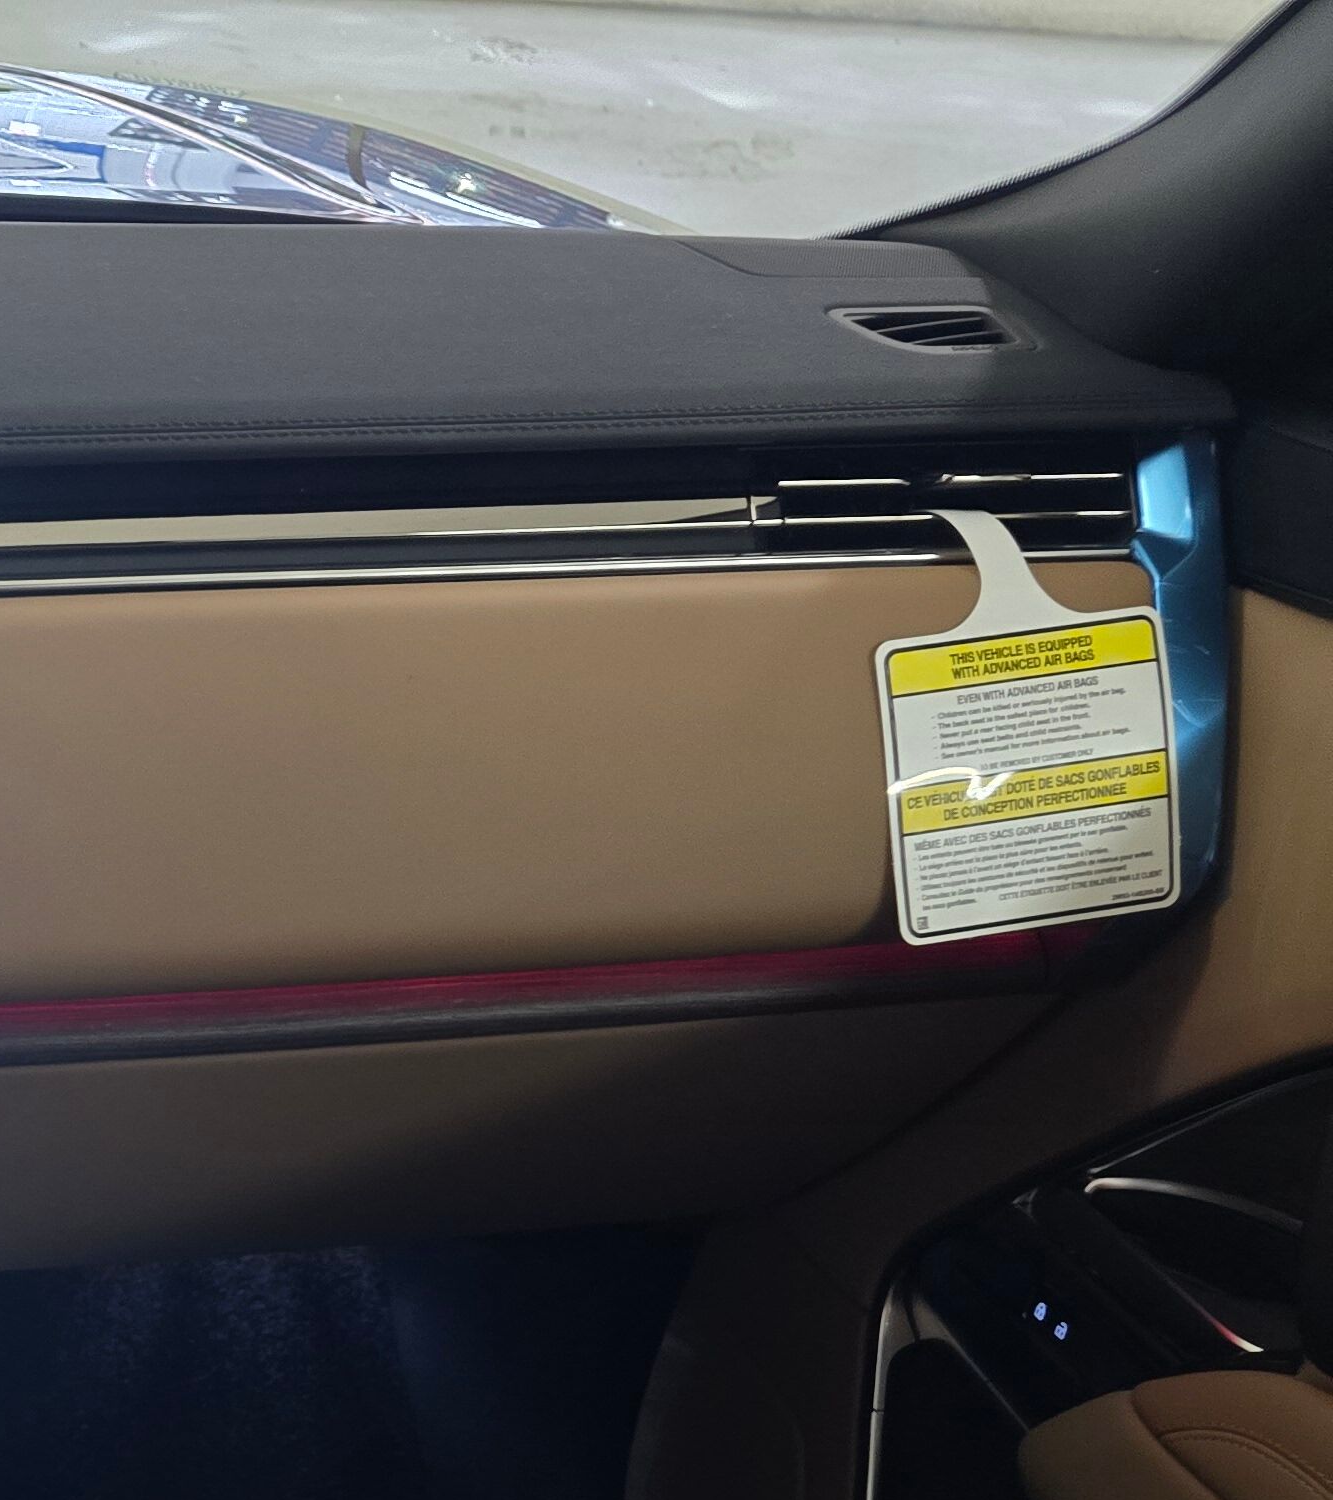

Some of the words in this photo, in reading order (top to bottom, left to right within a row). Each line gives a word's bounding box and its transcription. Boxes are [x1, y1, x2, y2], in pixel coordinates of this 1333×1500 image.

[949, 650, 974, 665] THIS
[977, 644, 1022, 661] VEHICLE
[1025, 642, 1035, 655] IS
[1038, 635, 1092, 653] EQUIPPED
[952, 664, 978, 678] WITH
[983, 656, 1040, 674] ADVANCED
[1043, 653, 1061, 666] AIR
[1065, 649, 1095, 663] BAGS
[956, 692, 980, 704] EVEN
[983, 689, 1004, 701] WITH
[1006, 682, 1054, 697] ADVANCED
[1057, 679, 1072, 690] AIR
[1073, 676, 1098, 688] BAGS
[906, 794, 923, 809] CE
[923, 784, 979, 807] VÉHICU
[1038, 776, 1053, 790] DE
[1055, 771, 1085, 787] SACS
[1087, 760, 1160, 783] GONFLABLES
[943, 807, 959, 820] DE
[960, 796, 1033, 818] CONCEPTION
[942, 834, 967, 847] AVEC
[969, 831, 988, 843] DES
[988, 827, 1014, 840] SACS
[1015, 818, 1076, 836] GONFLABLES
